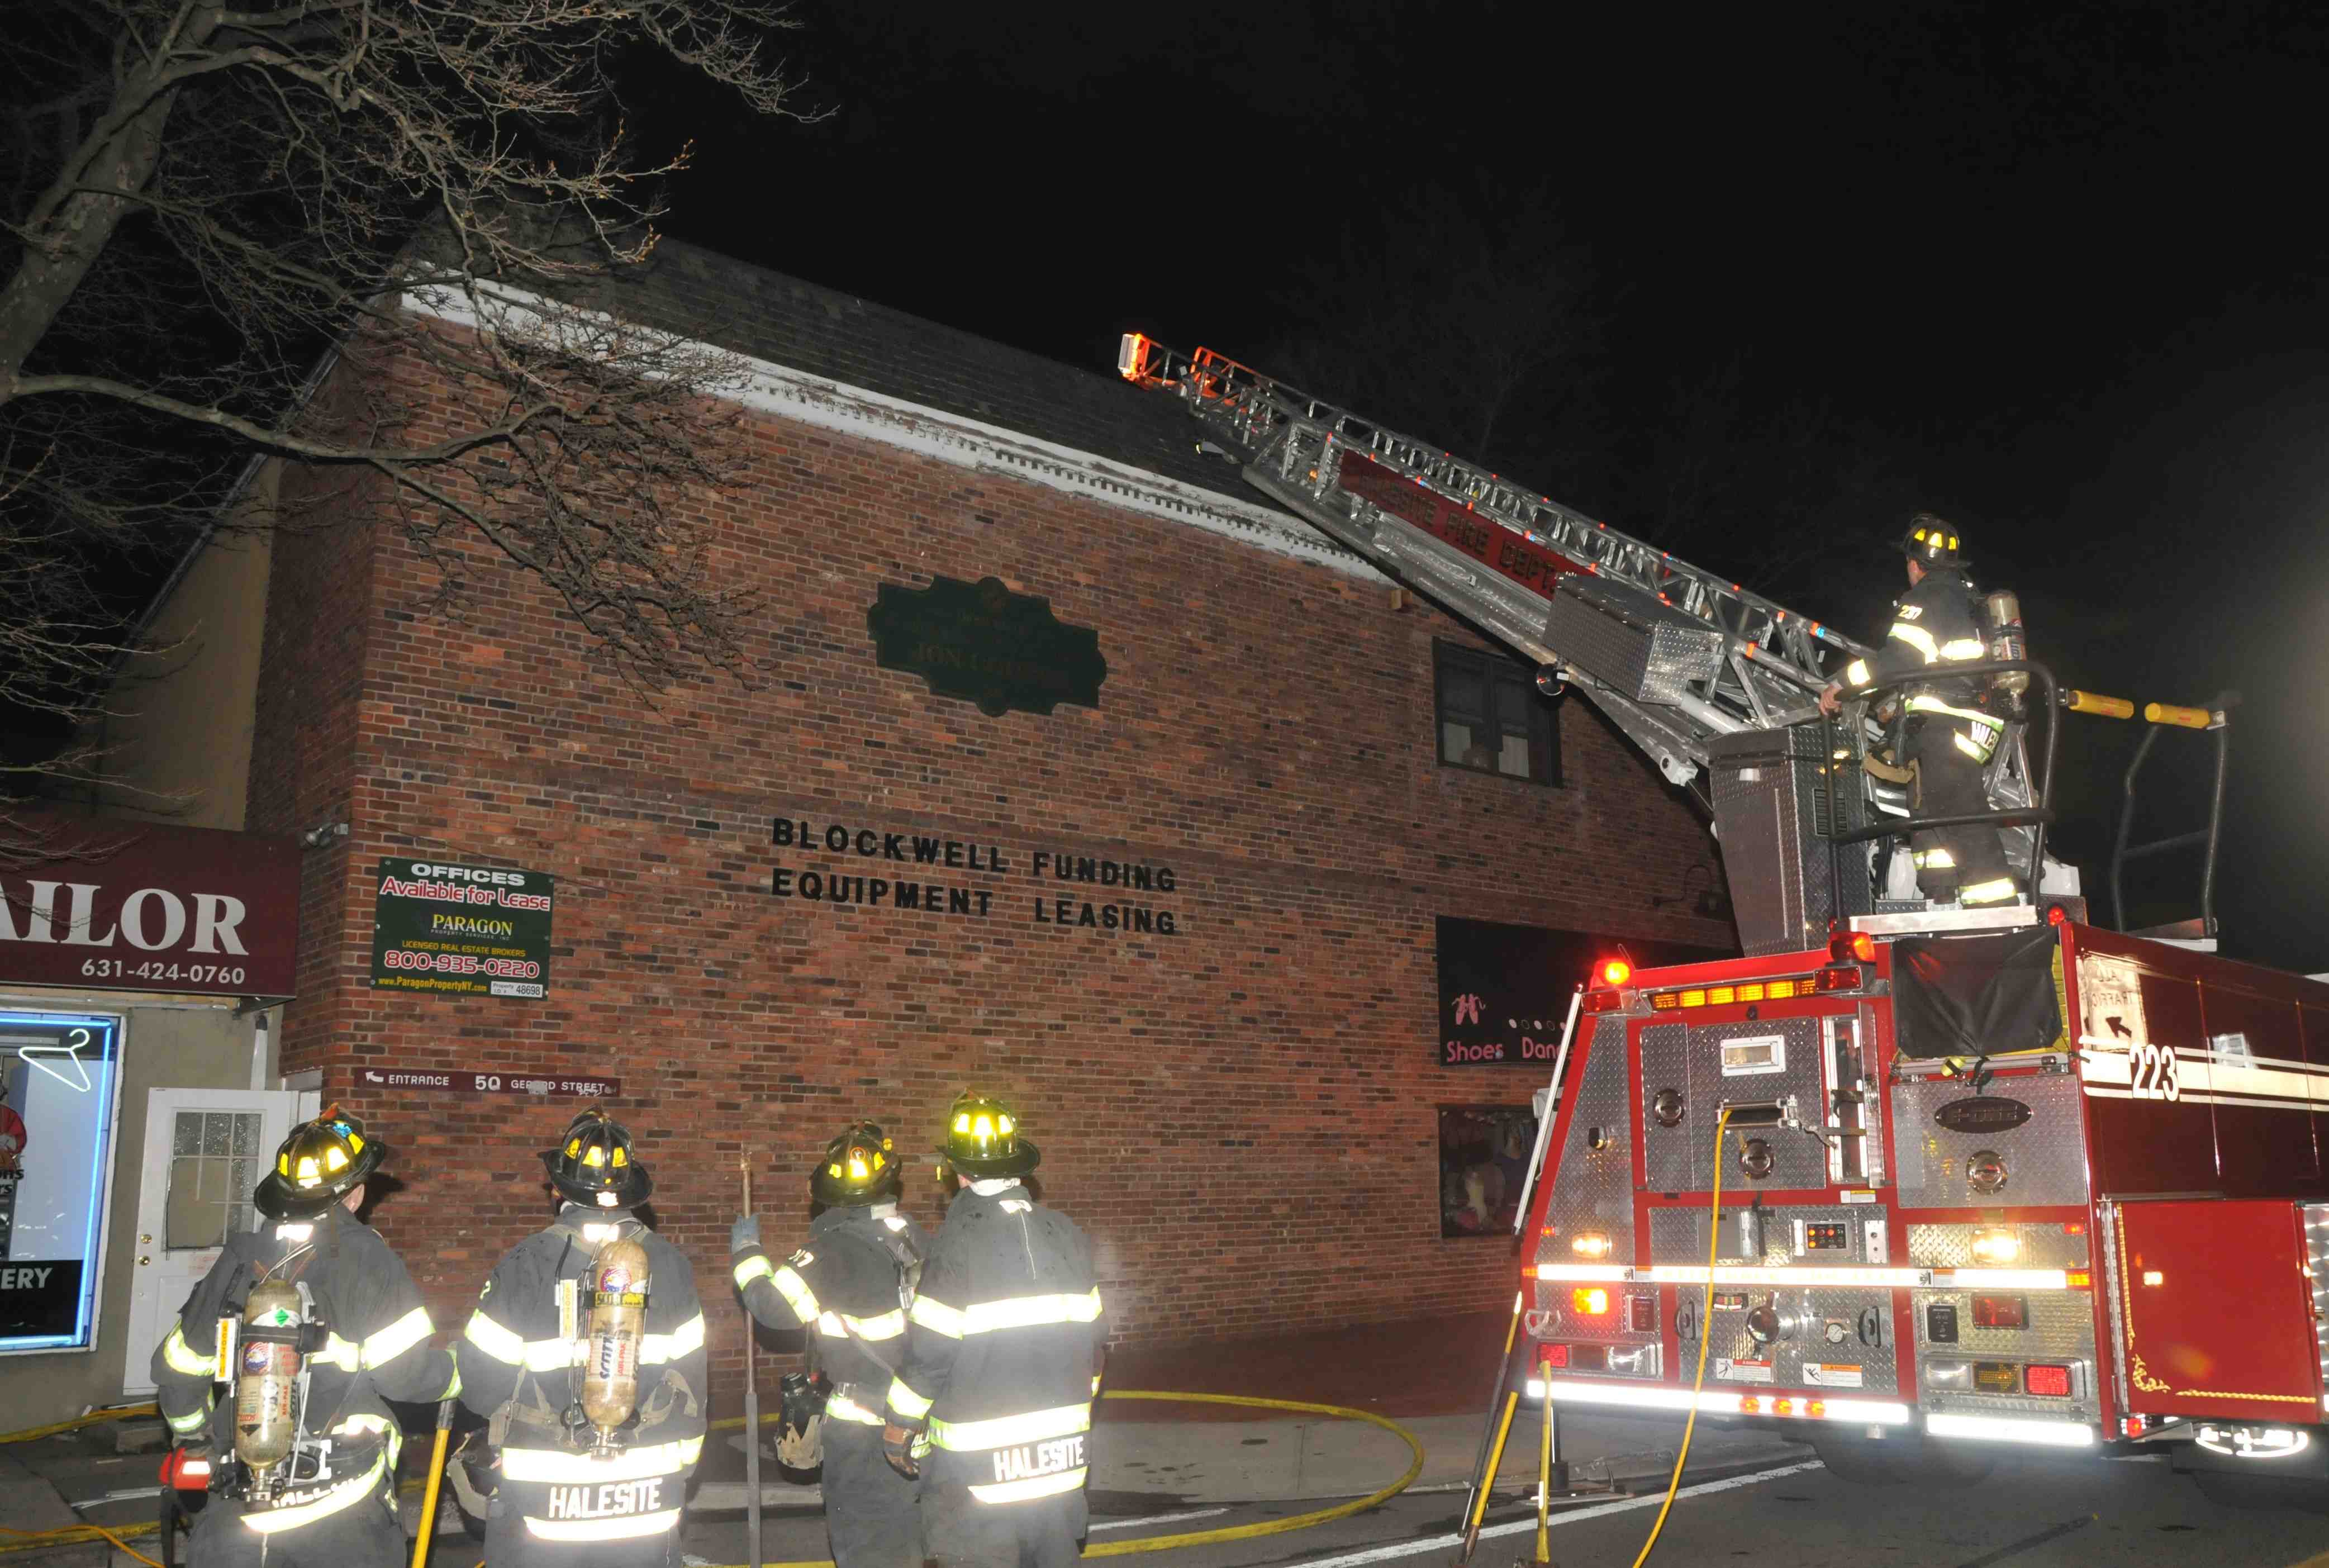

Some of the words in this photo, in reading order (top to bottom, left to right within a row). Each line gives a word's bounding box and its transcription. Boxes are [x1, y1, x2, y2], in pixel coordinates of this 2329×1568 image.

[1444, 511, 1490, 556] FIRE
[772, 817, 1010, 873] BLOCKWELL
[1033, 852, 1175, 893] FUNDING
[411, 863, 525, 886] OFFICES
[379, 876, 464, 903] Available
[466, 885, 496, 905] for
[498, 888, 550, 912] Lease
[772, 867, 992, 916] EQUIPMENT
[1035, 896, 1175, 937] LEASING
[432, 914, 513, 936] PARAGON
[402, 940, 439, 950] LICENSED
[441, 943, 459, 952] REAL
[462, 945, 489, 954] ESTATE
[491, 947, 526, 957] BROKERS
[82, 959, 245, 984] 631-424-0760
[384, 950, 539, 978] 800-935-0220
[378, 976, 487, 991] www.ParagonPropertyNY.com
[516, 985, 540, 995] 48698
[1446, 1040, 1504, 1062] Shoes
[1522, 1037, 1574, 1059] Dan
[388, 1074, 449, 1086] ENTRANCE
[561, 1081, 605, 1092] STREET
[2130, 1042, 2179, 1101] 223
[0, 1267, 53, 1290] ERY
[993, 1436, 1084, 1482] HALESITE
[549, 1477, 663, 1518] HALESITE
